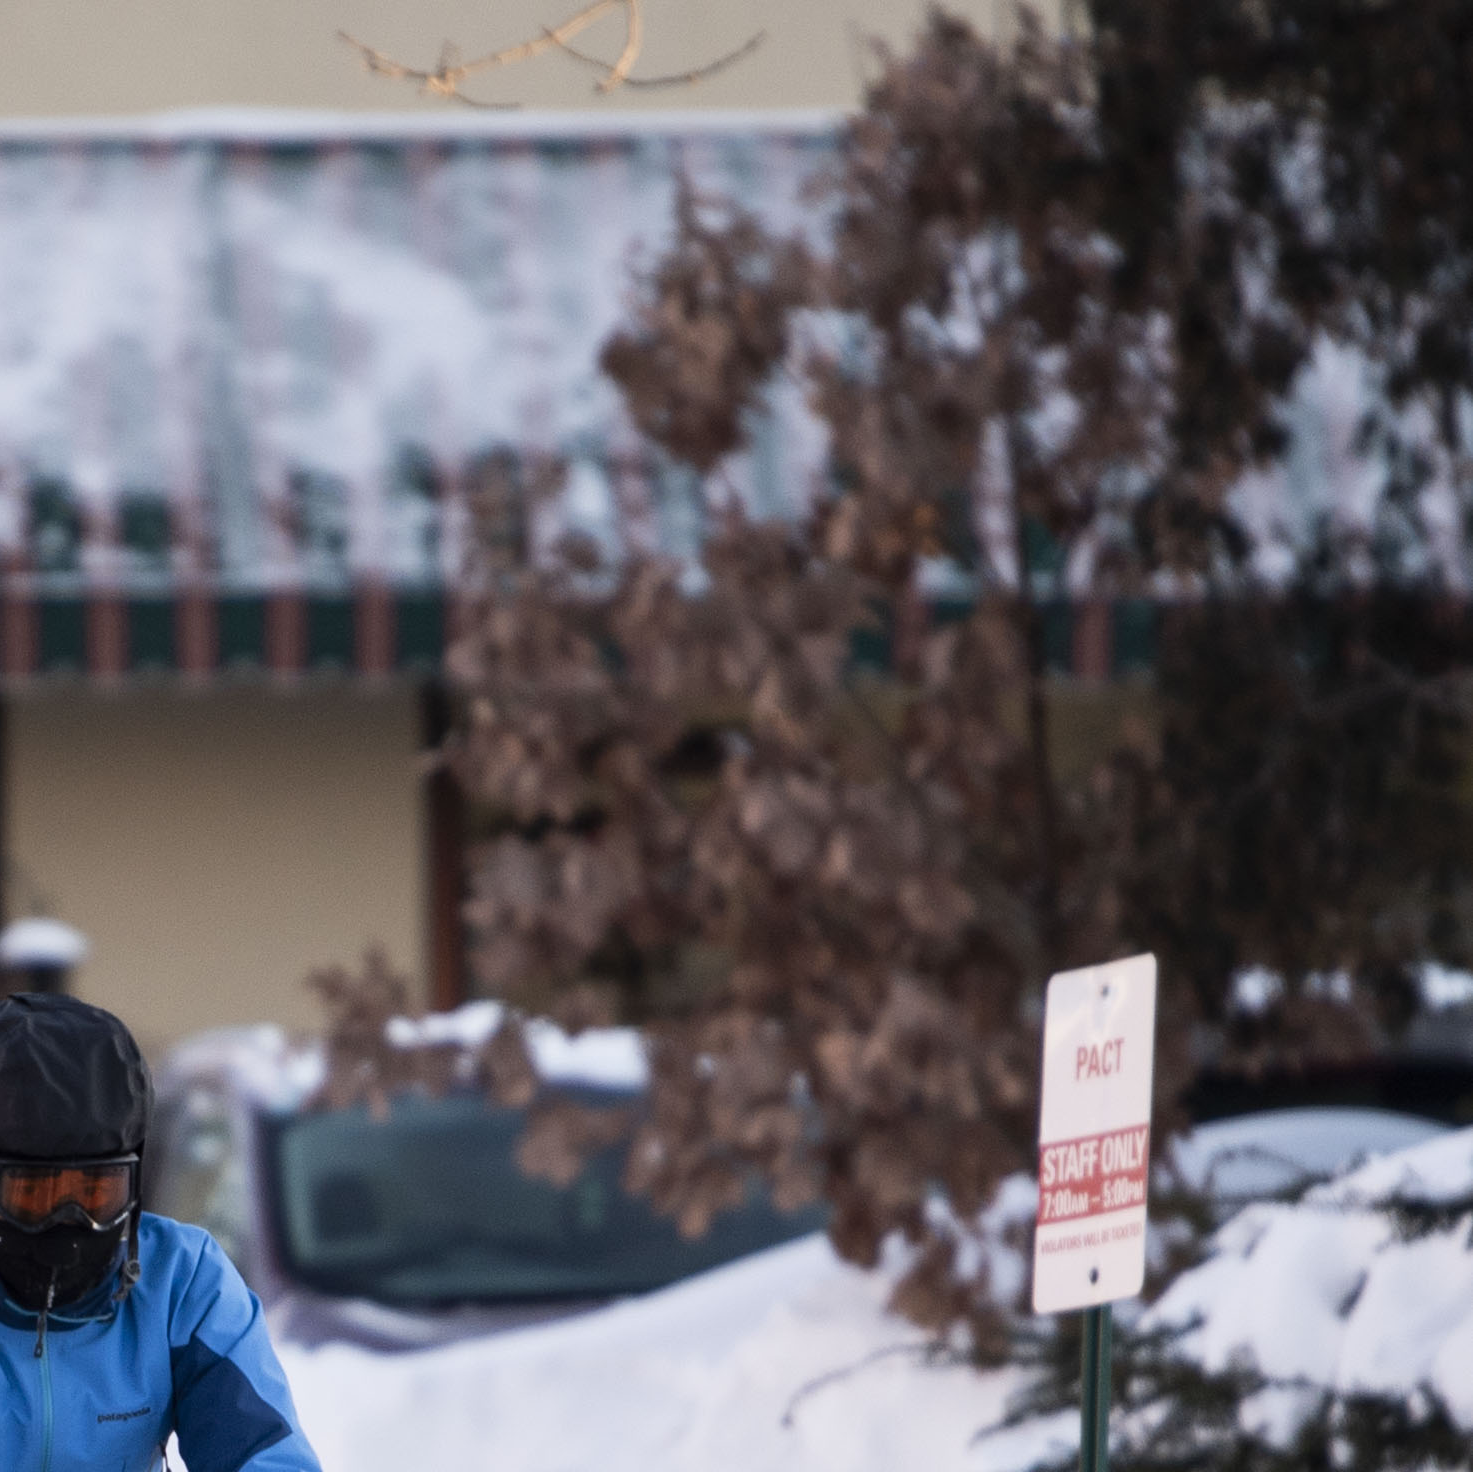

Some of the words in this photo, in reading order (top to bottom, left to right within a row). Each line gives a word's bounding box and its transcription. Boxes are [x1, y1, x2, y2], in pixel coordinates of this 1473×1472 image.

[1075, 1039, 1124, 1081] PACT
[1043, 1140, 1099, 1187] STAFF
[1101, 1128, 1147, 1174] ONLY
[1044, 1188, 1089, 1219] 7:00AM
[1103, 1177, 1144, 1208] 5:00PM
